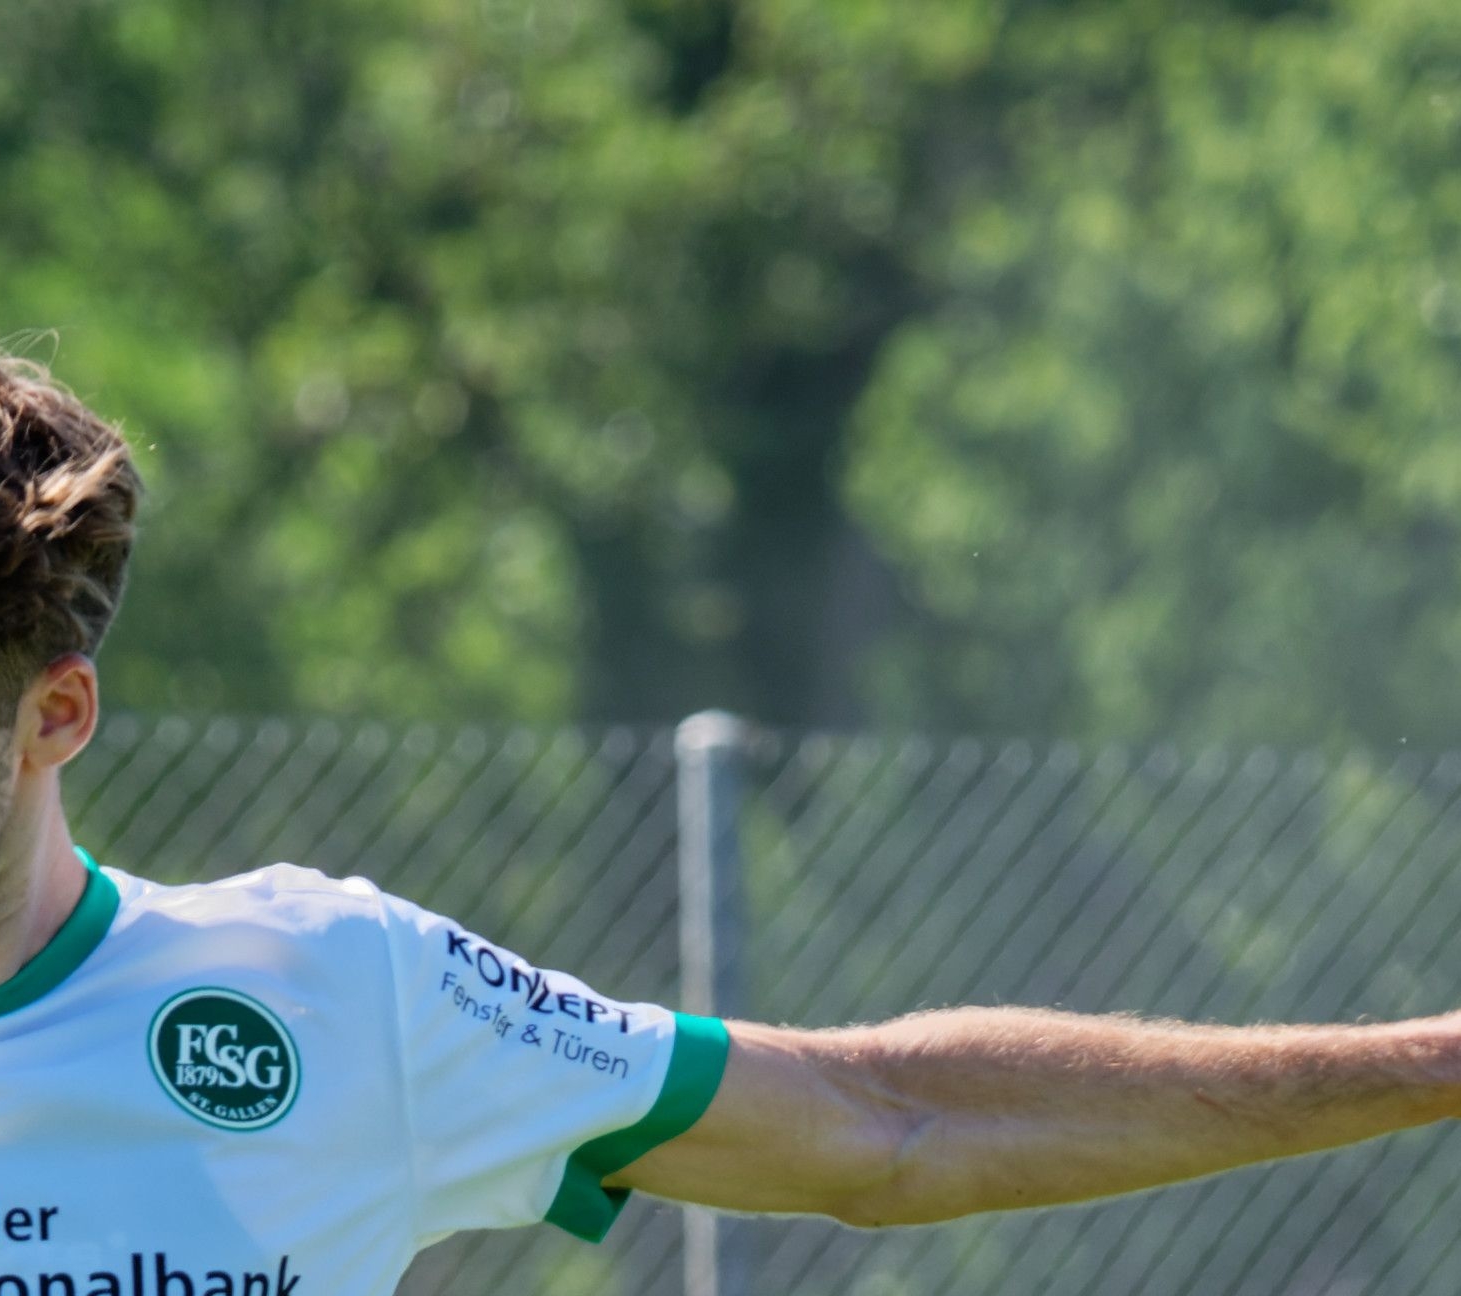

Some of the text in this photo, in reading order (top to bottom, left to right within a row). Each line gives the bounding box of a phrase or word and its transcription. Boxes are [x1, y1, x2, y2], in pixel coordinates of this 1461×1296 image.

[440, 971, 630, 1080] Fenster & Türen
[175, 1064, 220, 1087] 1879
[214, 1093, 279, 1121] GALLEN
